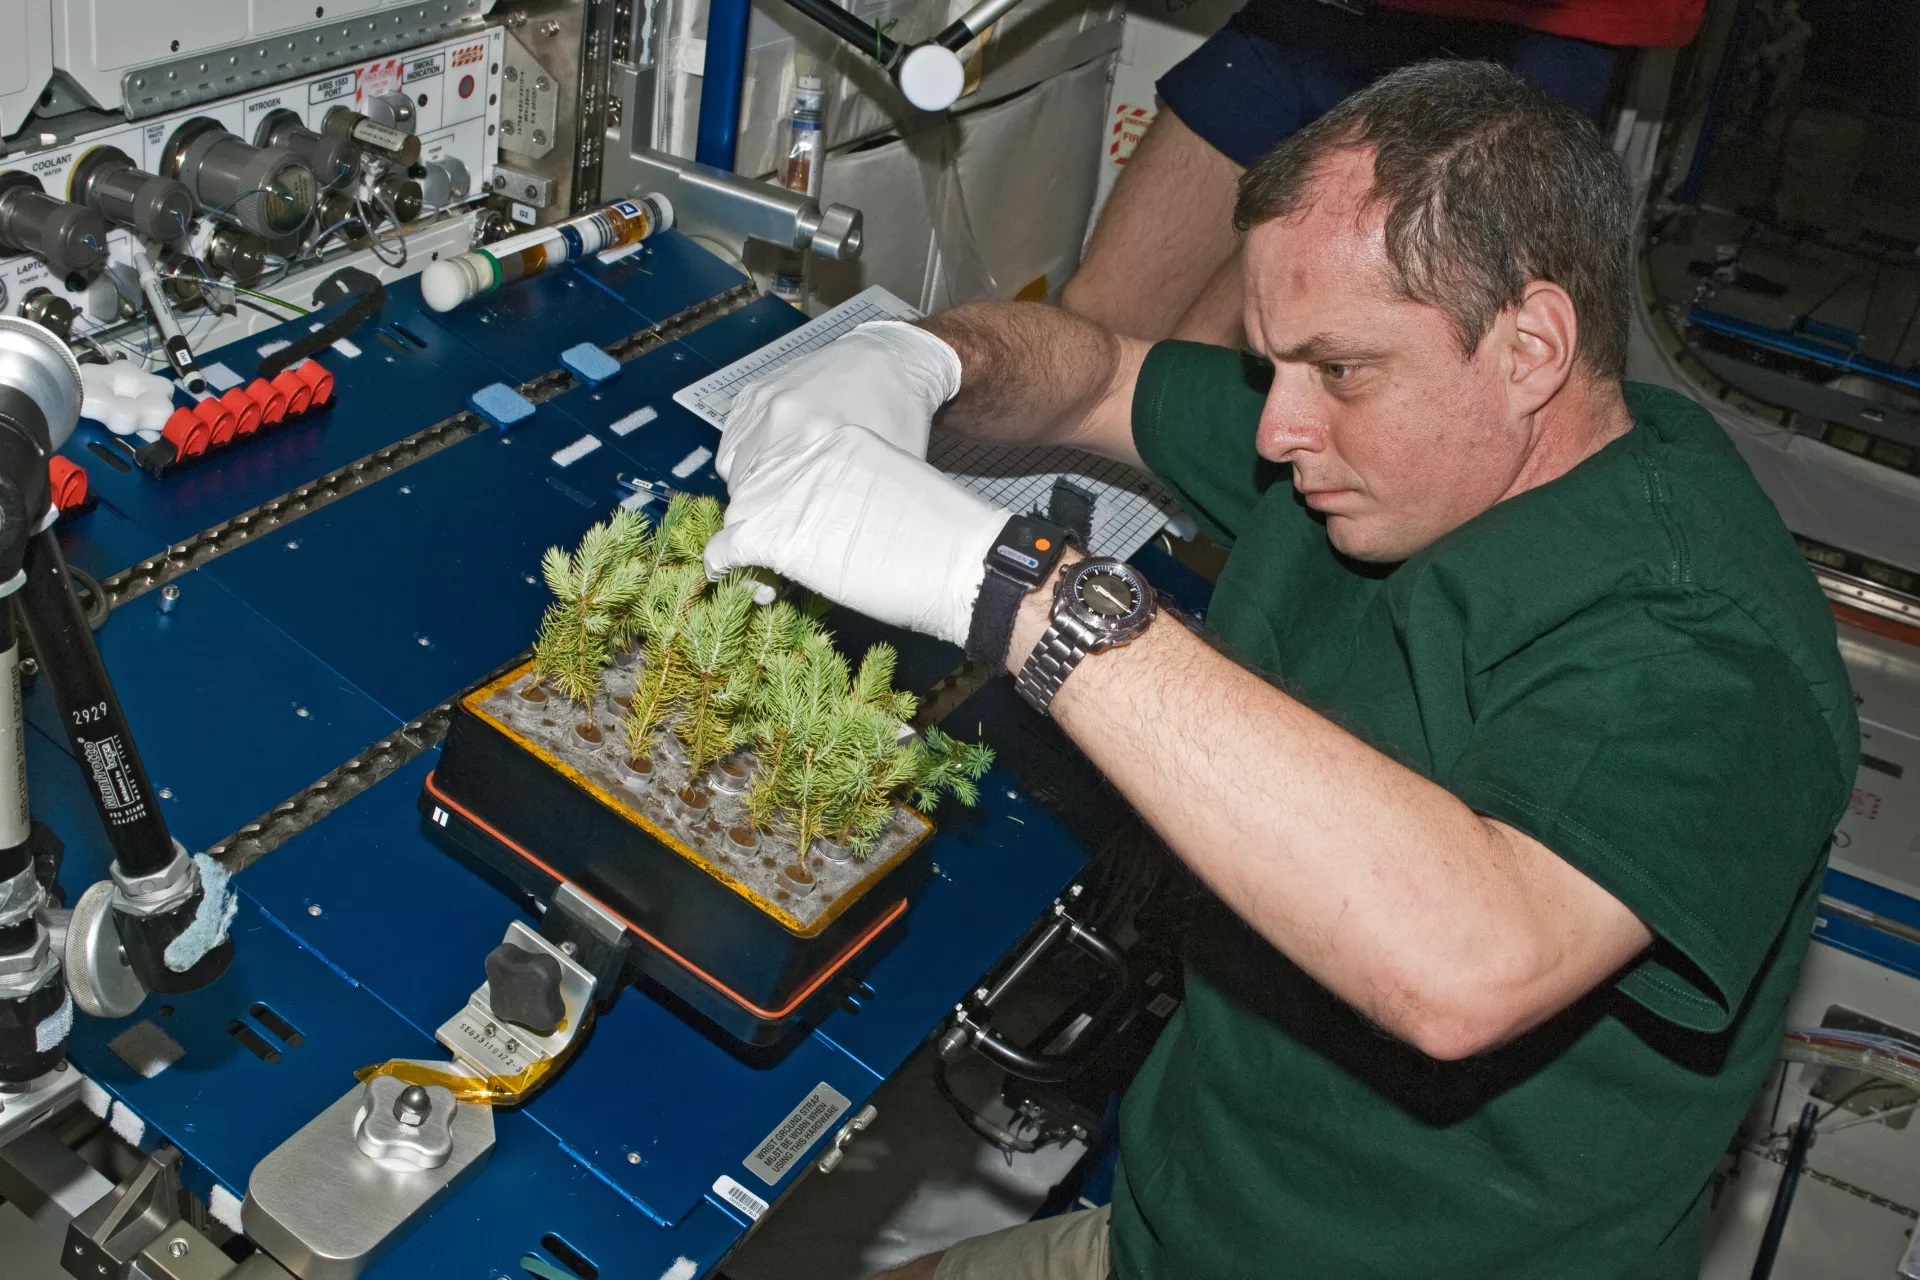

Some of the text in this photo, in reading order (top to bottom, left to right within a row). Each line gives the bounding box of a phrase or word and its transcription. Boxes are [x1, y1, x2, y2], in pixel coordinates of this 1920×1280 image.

[413, 58, 434, 70] SMOKE
[407, 65, 440, 80] INDICATION
[318, 77, 348, 92] ARIS 1553
[324, 87, 342, 98] PORT
[249, 98, 281, 112] NITROGEN
[147, 124, 165, 134] VACUUM
[148, 131, 163, 140] WASTE
[151, 138, 160, 146] GAS
[32, 154, 72, 171] COOLANT
[44, 168, 62, 176] WATER
[519, 210, 529, 218] G2
[11, 666, 21, 724] BRACKET
[72, 701, 107, 724] 2929
[113, 734, 126, 759] ITALY
[84, 742, 118, 809] Manfrotto
[125, 804, 144, 816] STAND
[756, 1094, 820, 1160] WRIST GROUND STRAP
[764, 1102, 828, 1167] MUST BE WORN WHEN
[772, 1104, 839, 1173] USING THIS HARDWARE
